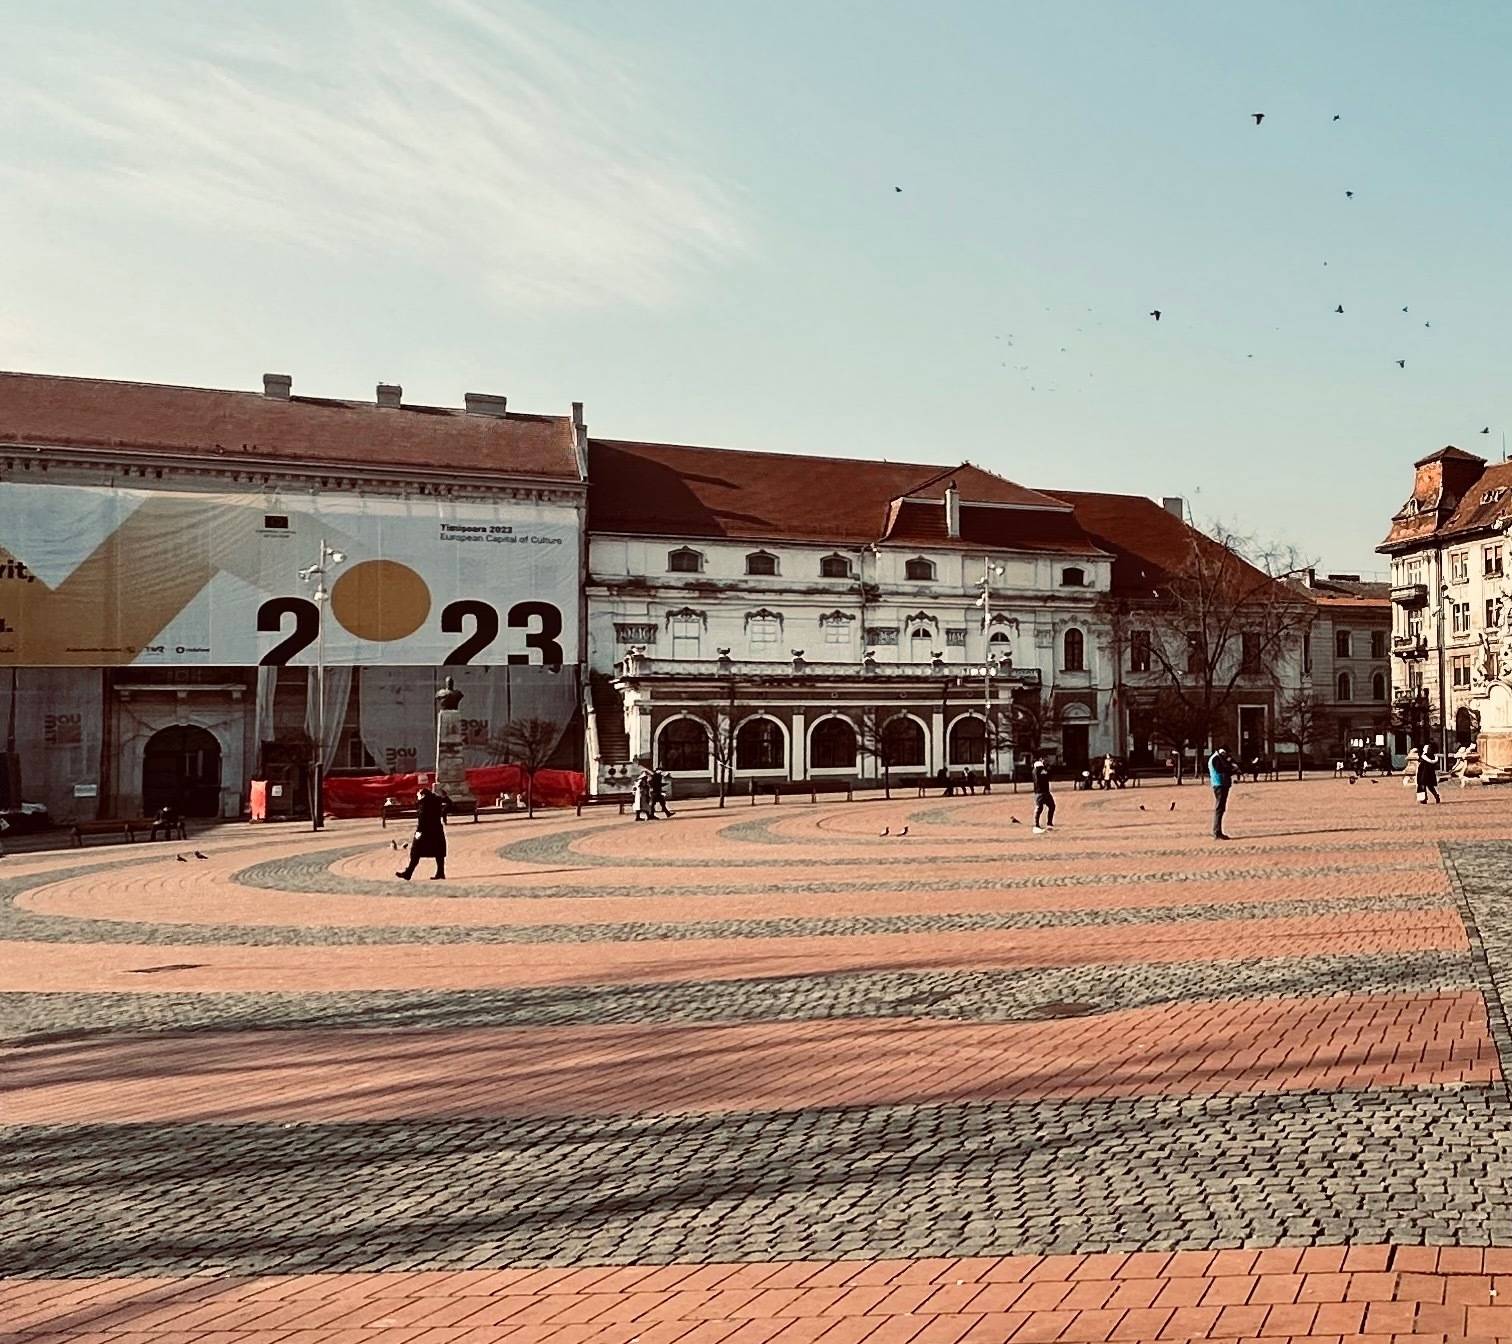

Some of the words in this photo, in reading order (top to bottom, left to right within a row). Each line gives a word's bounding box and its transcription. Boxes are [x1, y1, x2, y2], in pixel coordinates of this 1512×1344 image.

[440, 533, 484, 542] European
[486, 535, 517, 543] Capital
[519, 536, 528, 544] of
[531, 536, 562, 545] Culture
